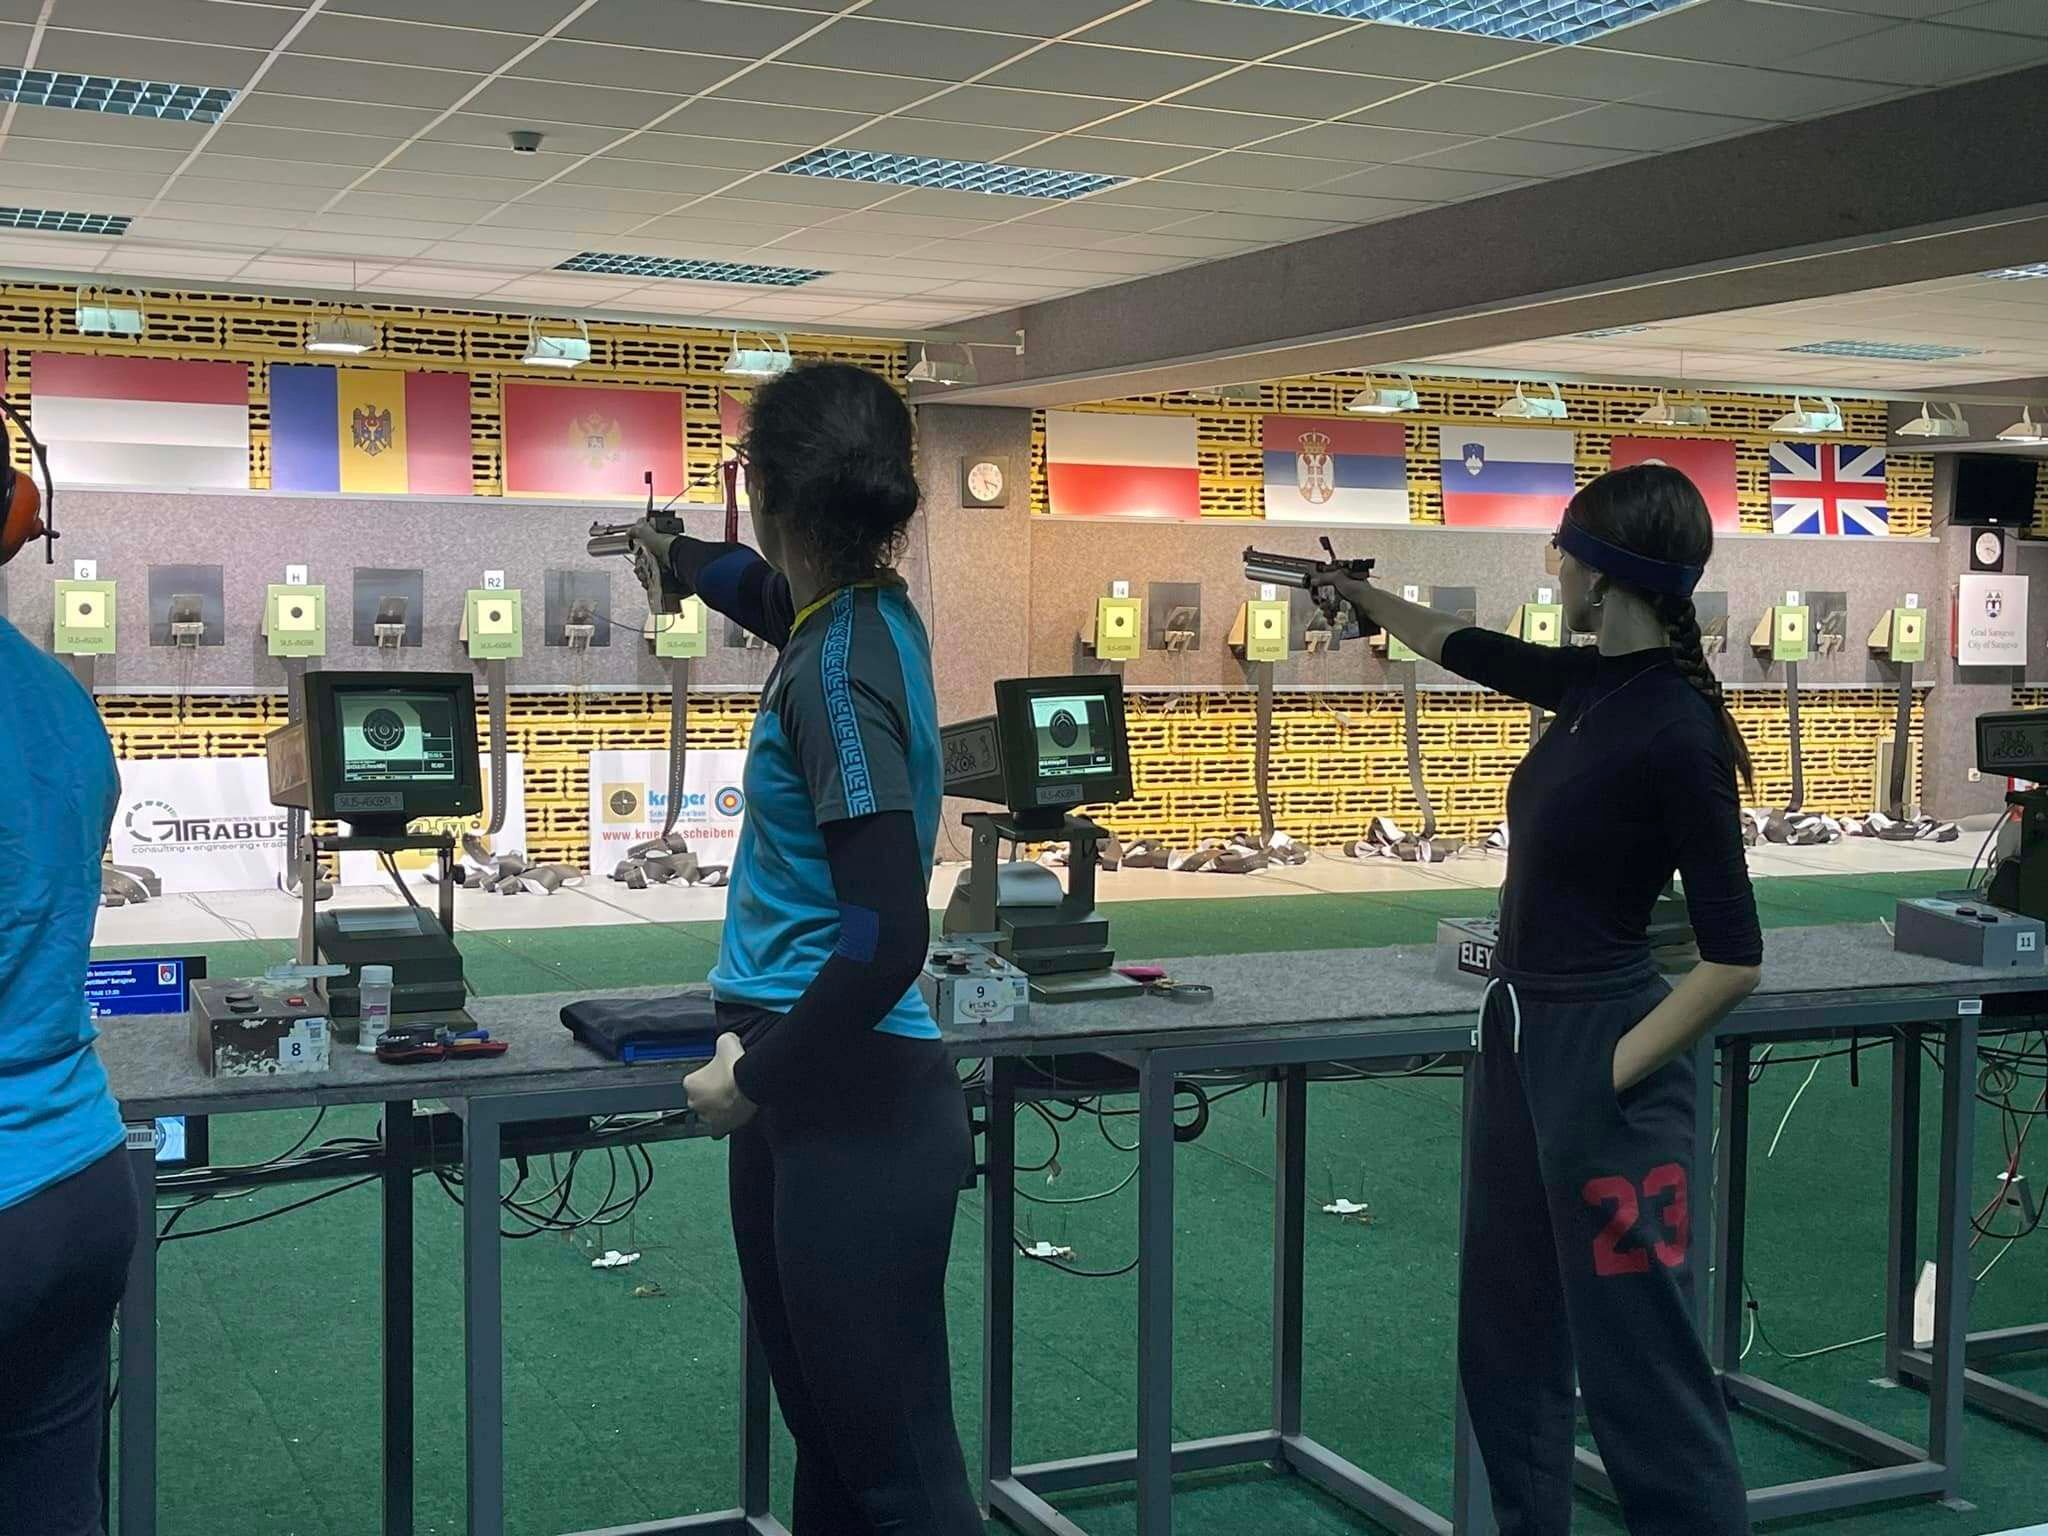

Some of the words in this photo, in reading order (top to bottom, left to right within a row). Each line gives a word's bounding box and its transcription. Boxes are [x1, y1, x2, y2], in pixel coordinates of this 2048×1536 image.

[80, 567, 89, 578] G
[292, 573, 300, 583] H
[487, 578, 501, 588] R2
[648, 791, 706, 809] krger
[131, 844, 186, 854] consulting
[193, 842, 255, 852] engineering
[2020, 937, 2031, 947] 11
[1461, 942, 1493, 970] ELEY
[976, 986, 985, 998] 9
[291, 1043, 301, 1056] 8
[1582, 1162, 1689, 1277] 23
